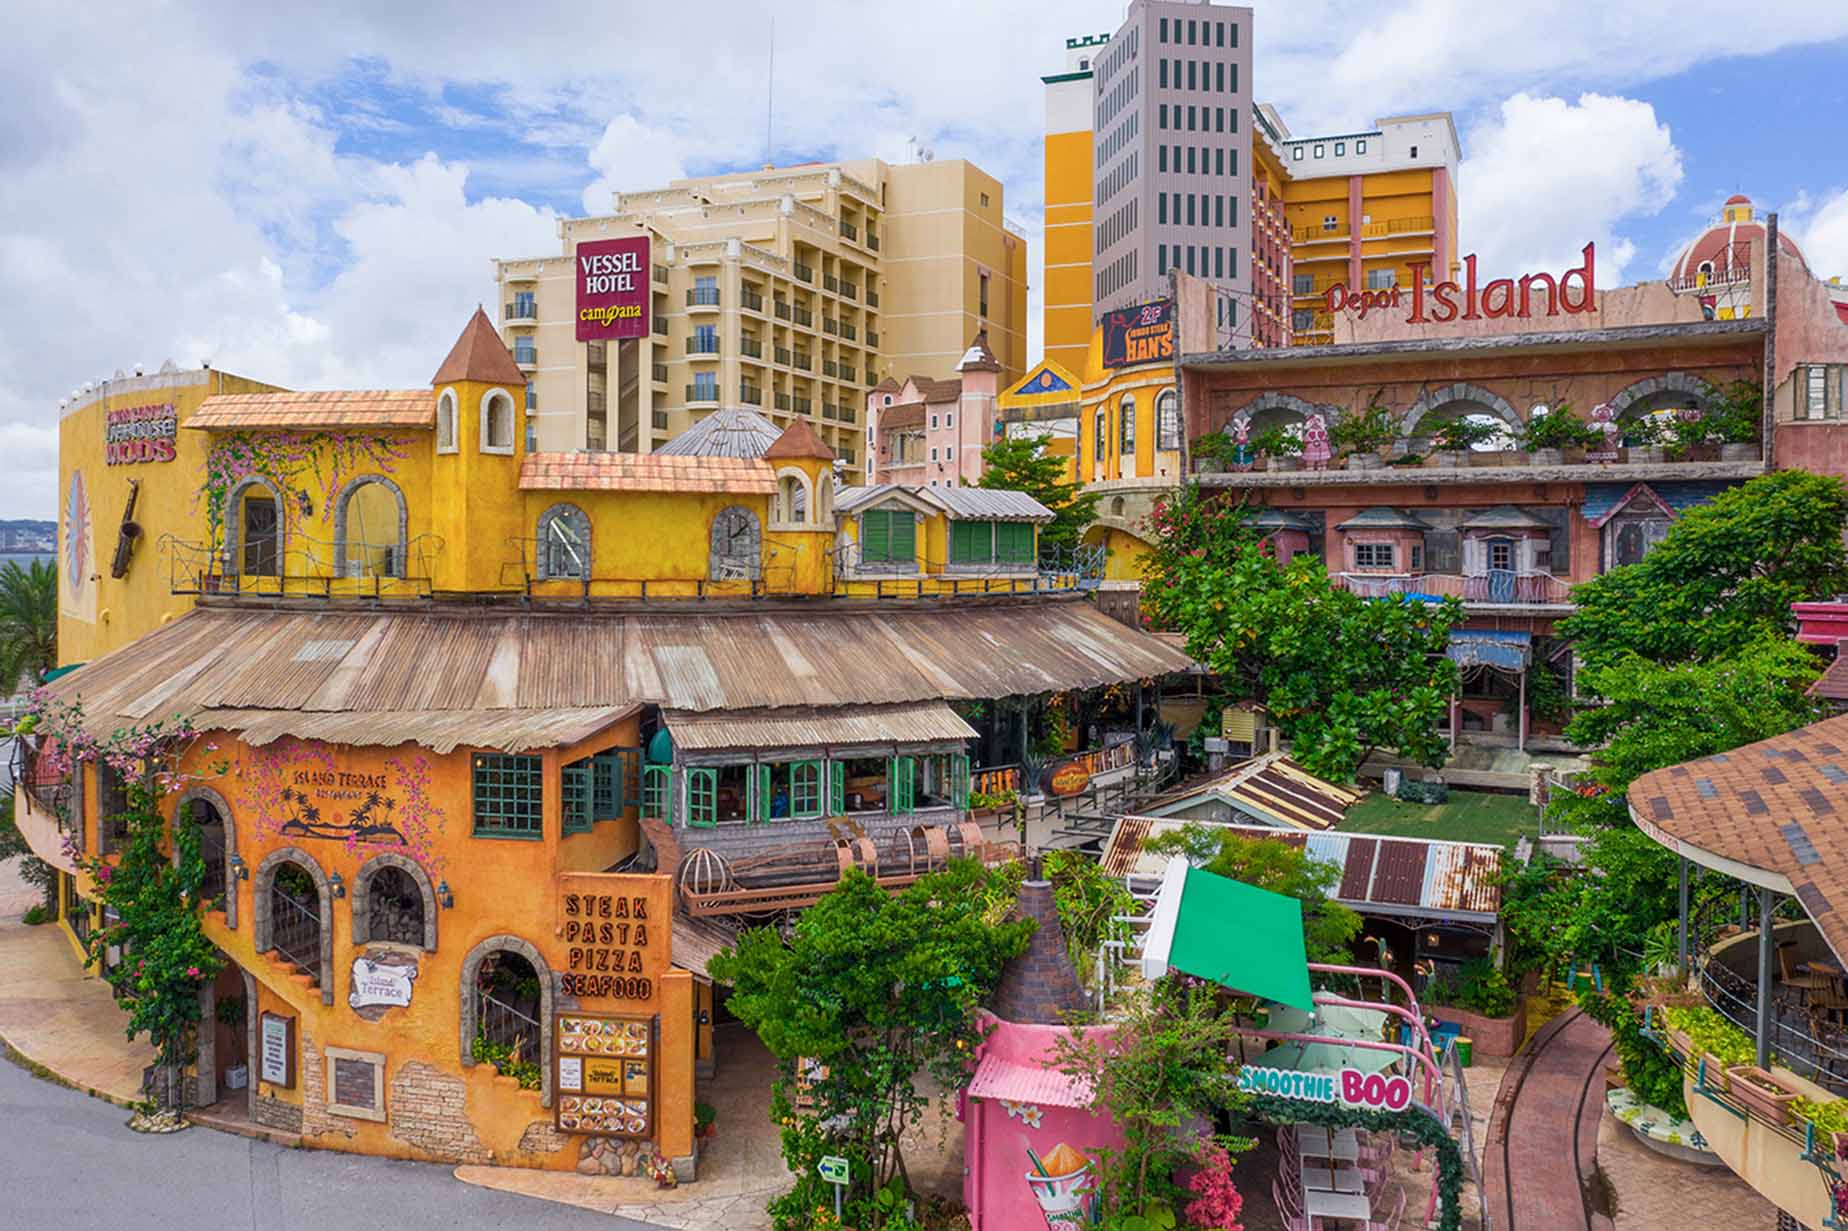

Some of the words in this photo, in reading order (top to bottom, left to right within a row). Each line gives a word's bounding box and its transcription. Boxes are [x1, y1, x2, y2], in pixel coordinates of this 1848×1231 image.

[581, 252, 642, 275] VESSEL
[586, 274, 636, 294] HOTEL
[1320, 282, 1400, 320] Depot
[1405, 241, 1598, 324] Island
[580, 305, 642, 326] campana
[1141, 306, 1161, 325] 2F
[566, 894, 648, 919] STEAK
[566, 921, 648, 946] PASTA
[569, 947, 642, 973] PIZZA
[361, 982, 403, 998] Terrace
[561, 972, 652, 1001] SEAFOOD
[1238, 1065, 1335, 1103] SMOOTHIE
[1341, 1068, 1410, 1110] BOO
